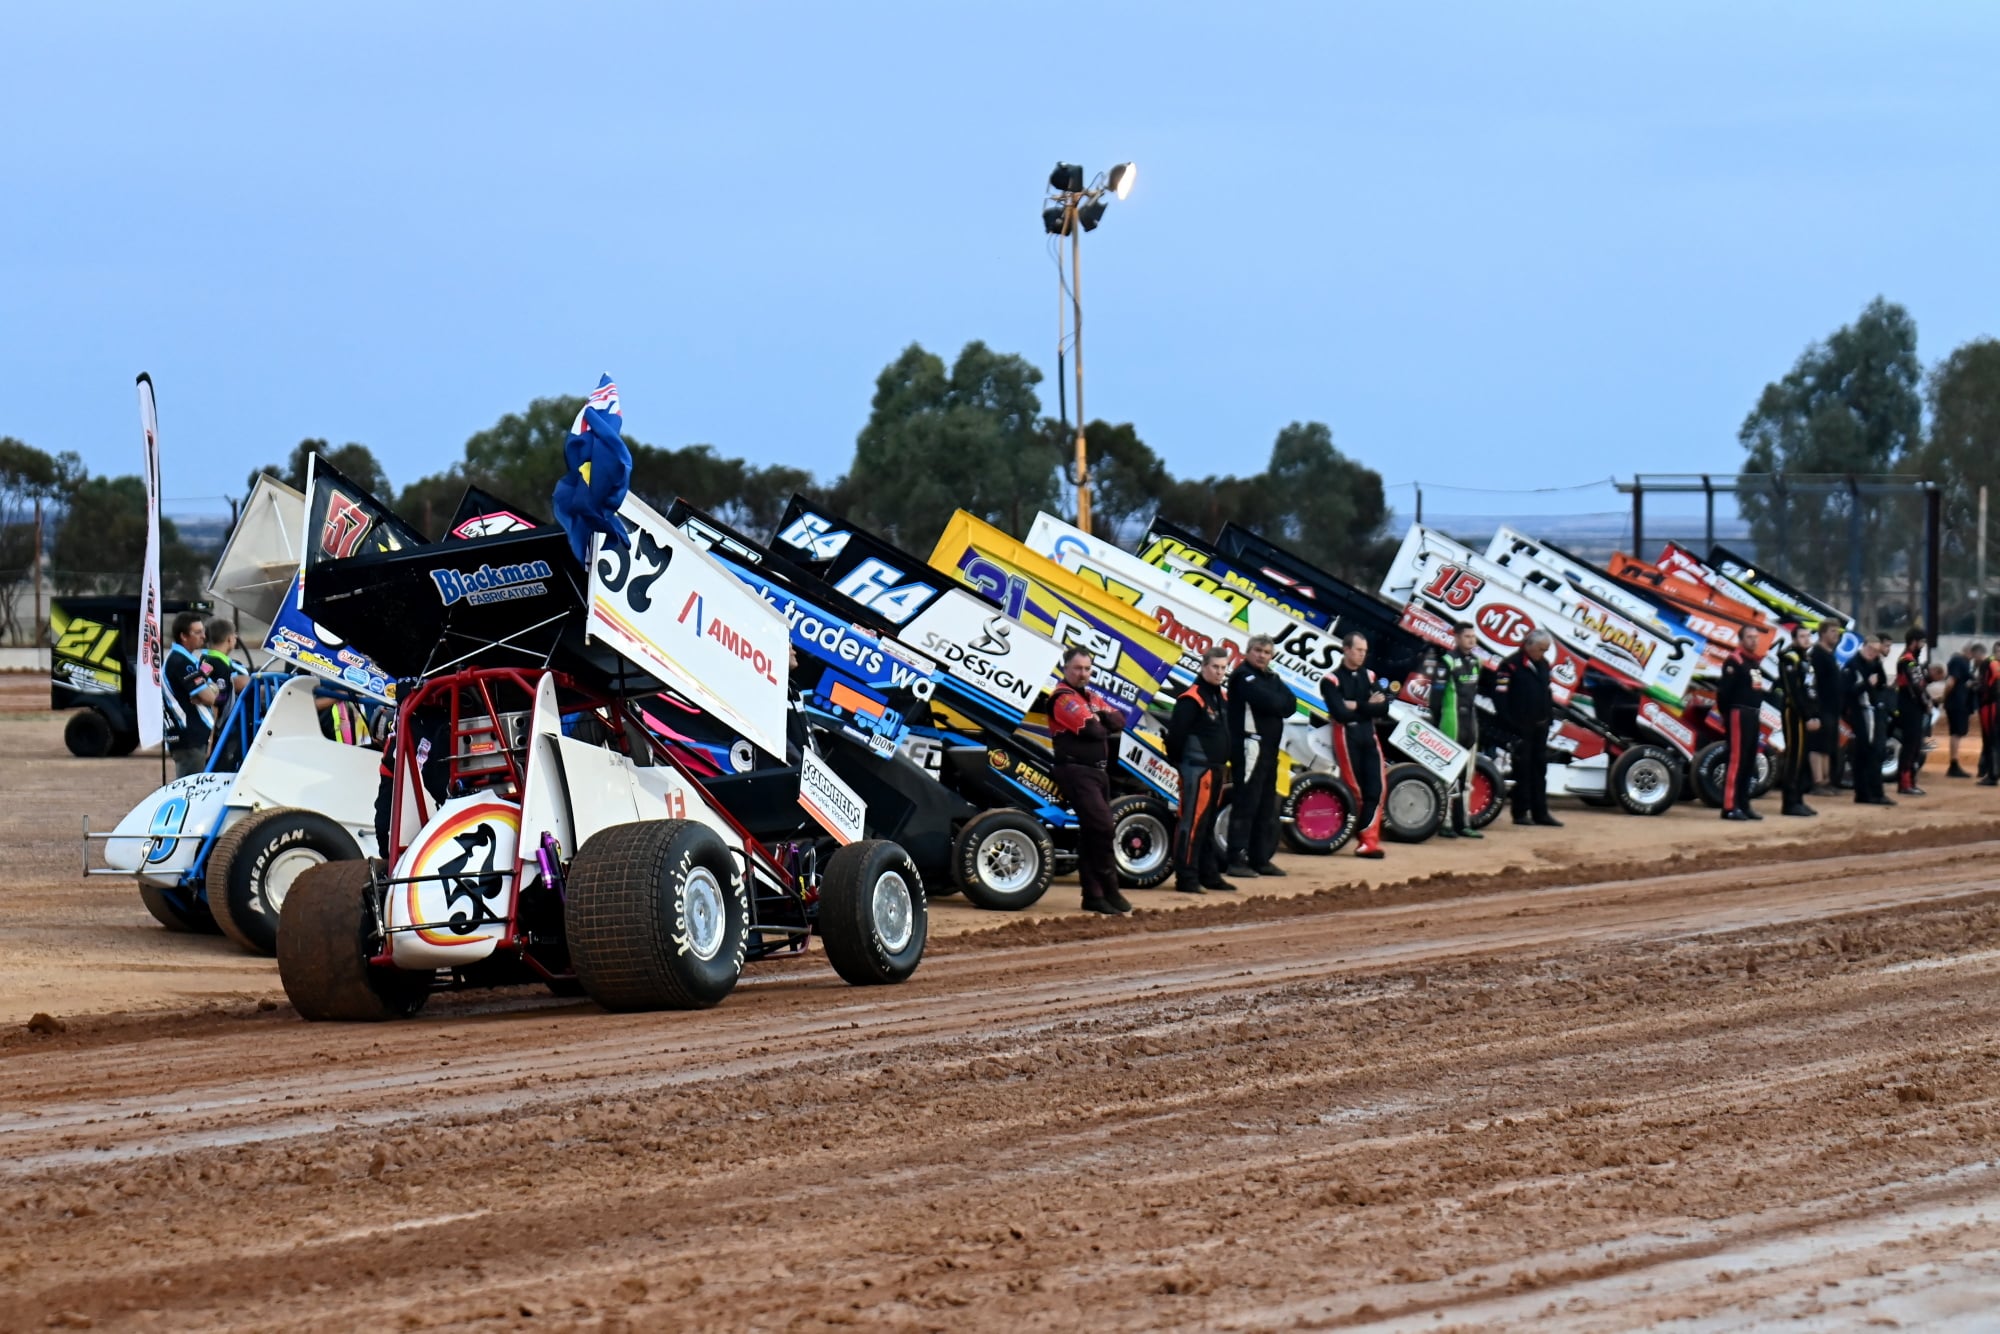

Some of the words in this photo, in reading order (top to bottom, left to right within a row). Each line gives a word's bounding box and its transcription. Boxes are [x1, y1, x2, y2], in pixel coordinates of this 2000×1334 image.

[322, 489, 372, 559] 57
[777, 512, 854, 562] 64
[430, 559, 553, 606] Blackman
[469, 583, 547, 605] FABRICATIONS
[596, 514, 673, 613] 57
[834, 556, 938, 624] 64
[1422, 564, 1485, 610] 15
[55, 617, 121, 673] 21
[707, 618, 777, 686] AMPOL
[783, 599, 883, 674] traders
[891, 662, 936, 702] wa
[1272, 621, 1344, 669] J&S
[1413, 618, 1457, 649] KENWOR
[1479, 608, 1531, 643] MTS
[803, 759, 861, 829] SCARDIFIELDS
[143, 796, 190, 864] 9
[249, 827, 305, 915] AMERICAN
